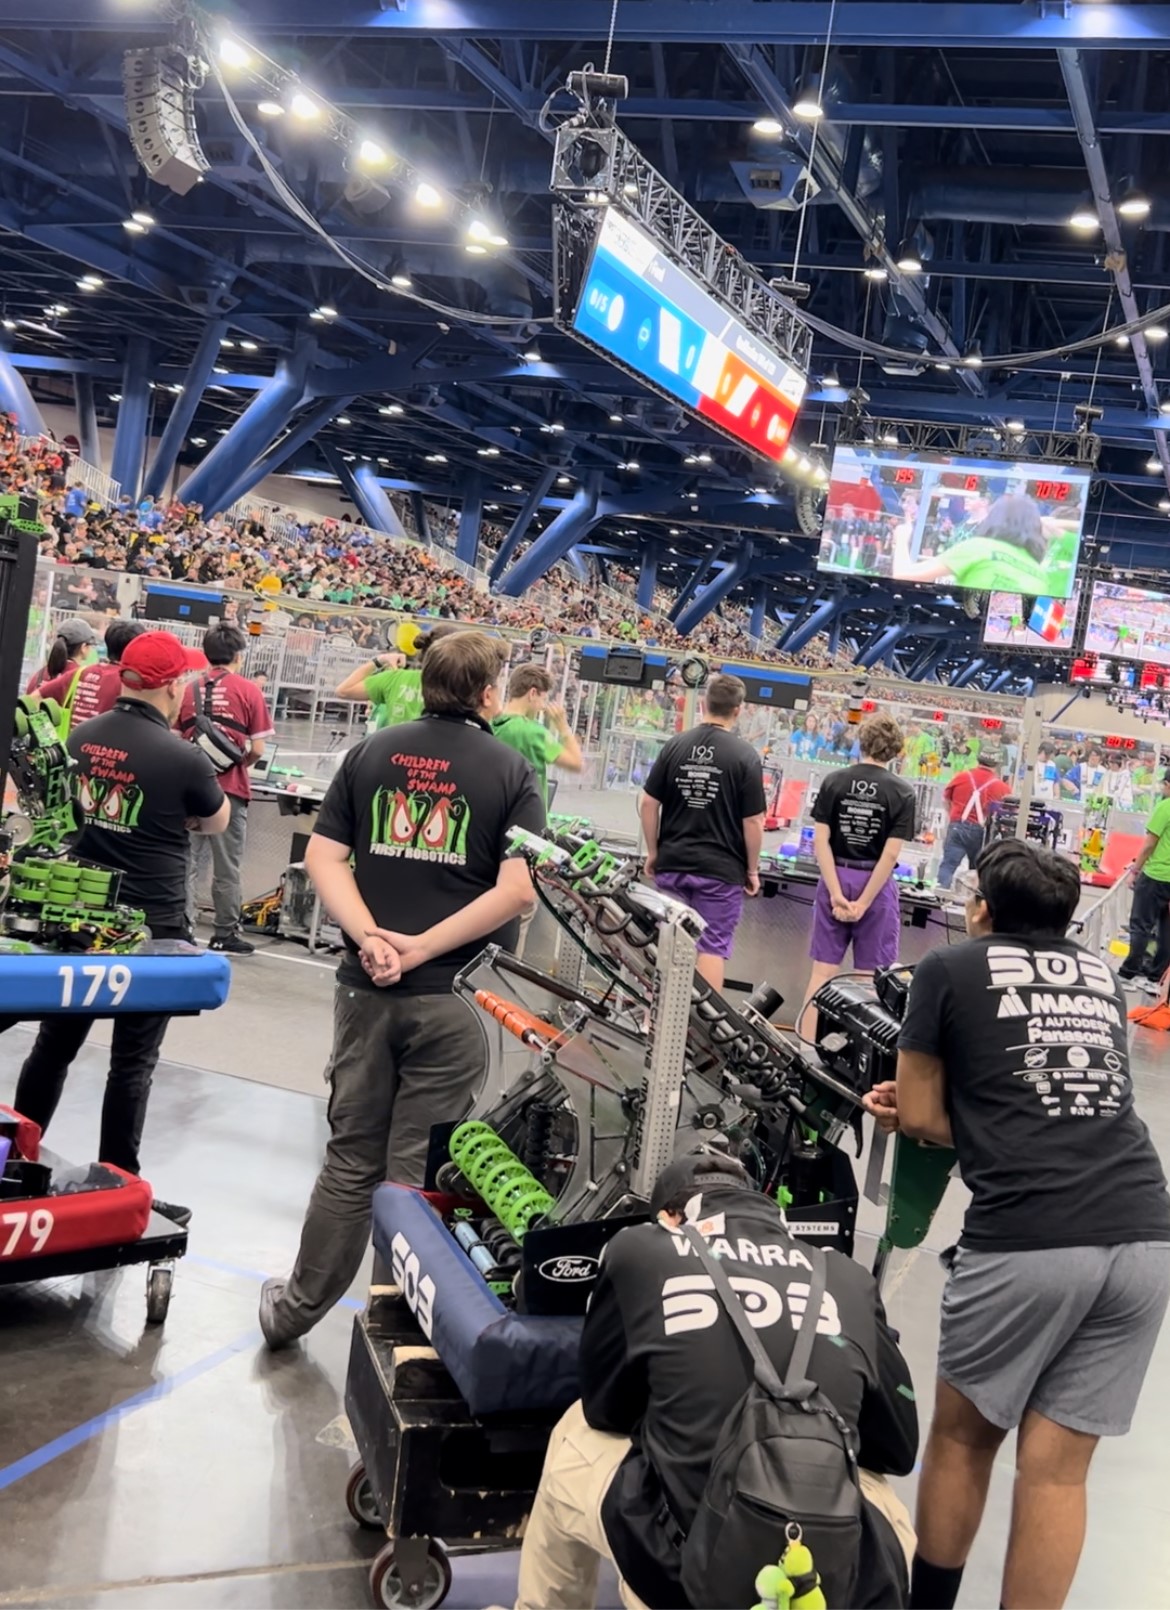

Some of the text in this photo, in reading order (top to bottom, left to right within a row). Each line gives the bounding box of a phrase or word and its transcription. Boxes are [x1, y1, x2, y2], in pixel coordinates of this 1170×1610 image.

[895, 468, 914, 484] 195
[964, 475, 979, 491] 15
[1034, 480, 1071, 500] 7072
[81, 743, 128, 762] CHILDREN
[90, 756, 116, 768] OF THE
[690, 745, 716, 761] 195
[391, 753, 451, 772] CHILDREN
[90, 765, 135, 783] SWAMP
[407, 768, 437, 780] OF THE
[407, 779, 457, 795] SWAMP
[851, 780, 879, 797] 195
[369, 842, 467, 866] FIRST ROBOTICS
[986, 946, 1116, 995] 503
[58, 964, 132, 1008] 179
[1031, 993, 1123, 1029] MAGNA
[1045, 1017, 1112, 1034] AUTODESK
[1027, 1028, 1115, 1049] Panasonic
[632, 1076, 649, 1171] MACHINE
[795, 1224, 836, 1232] SYSTEMS
[551, 1257, 592, 1278] Ford
[390, 1230, 437, 1341] 503
